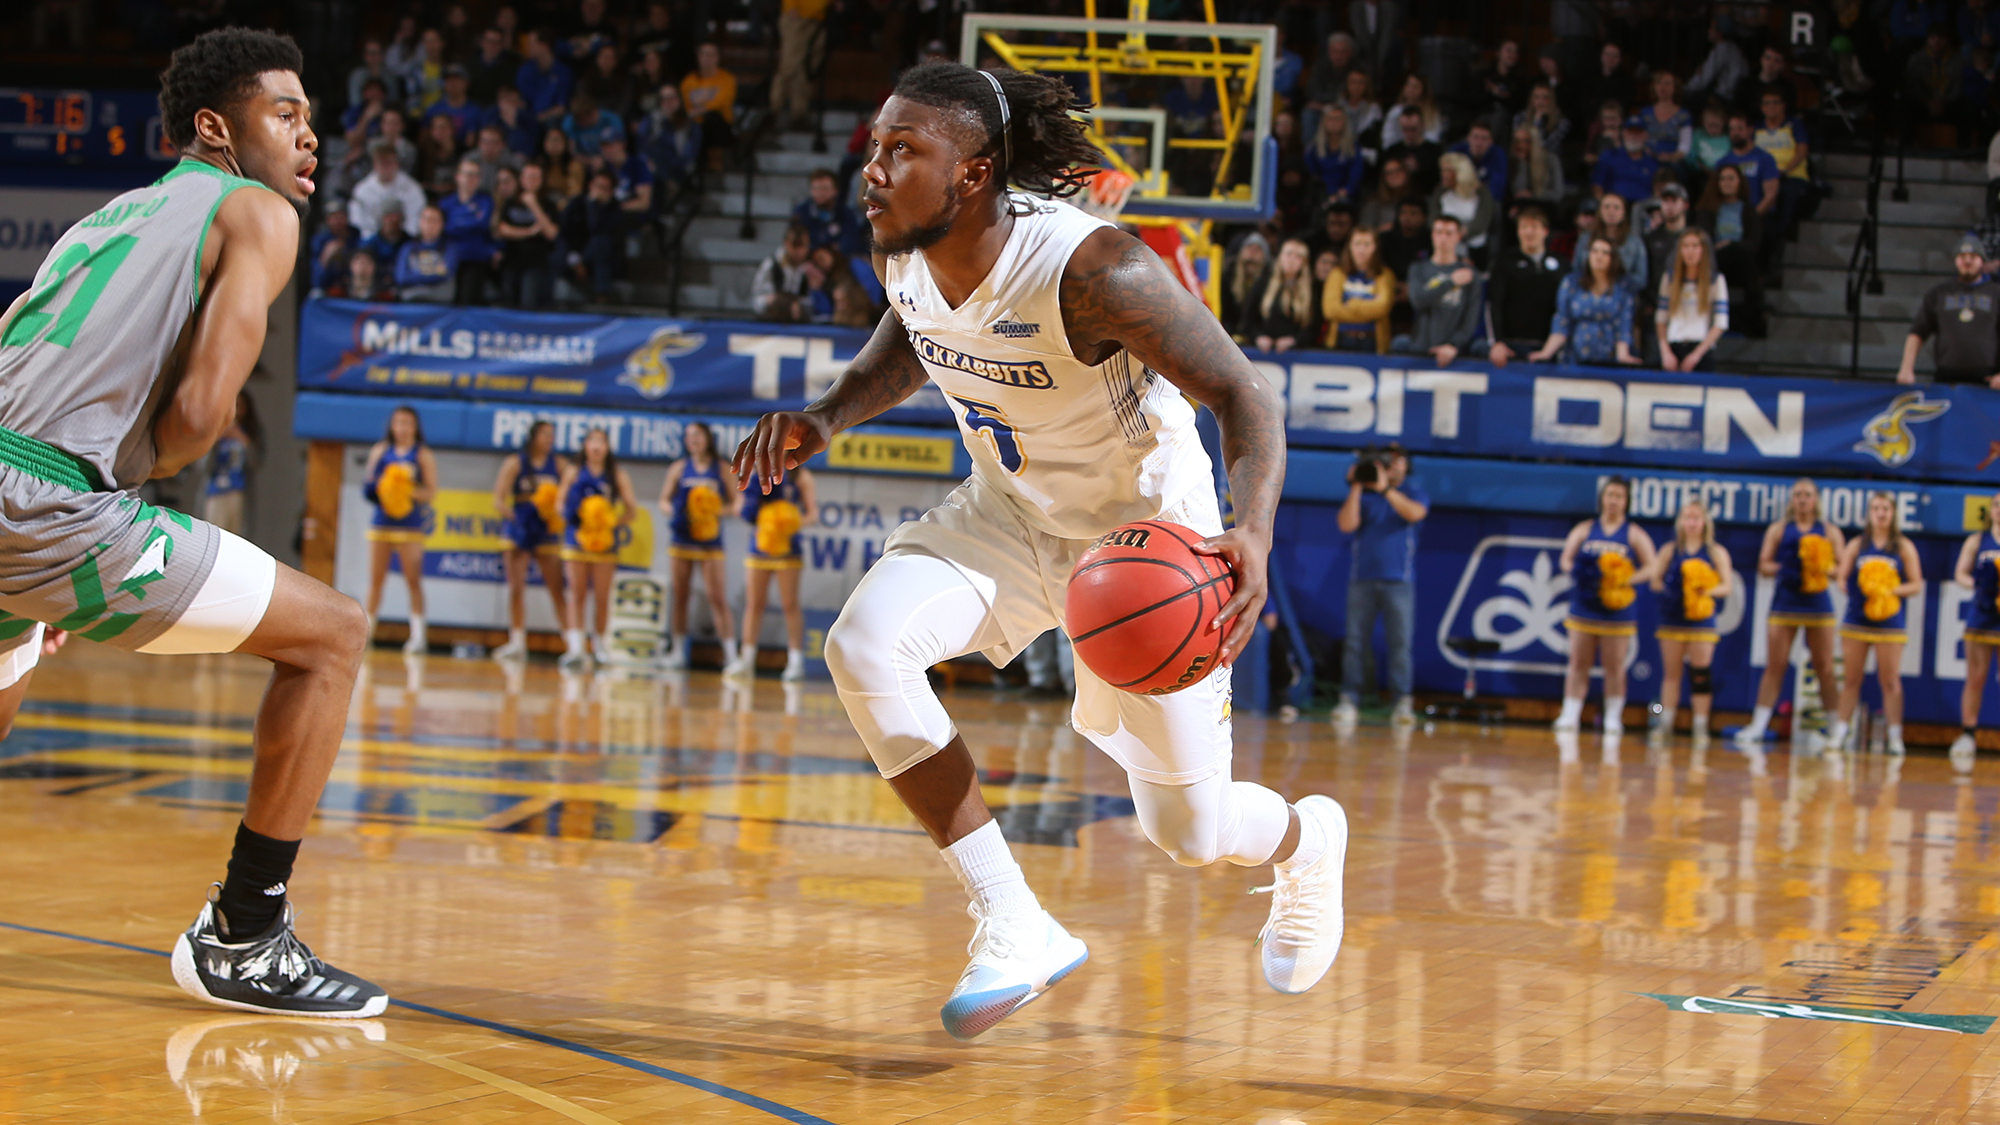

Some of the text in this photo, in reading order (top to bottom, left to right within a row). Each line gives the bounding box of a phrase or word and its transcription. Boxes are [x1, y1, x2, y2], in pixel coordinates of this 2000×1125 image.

[1790, 12, 1813, 45] R
[1, 233, 140, 349] 21
[992, 323, 1041, 334] SUMMIT
[630, 416, 684, 458] THIS
[946, 391, 1028, 477] 5
[1531, 377, 1805, 457] DEN
